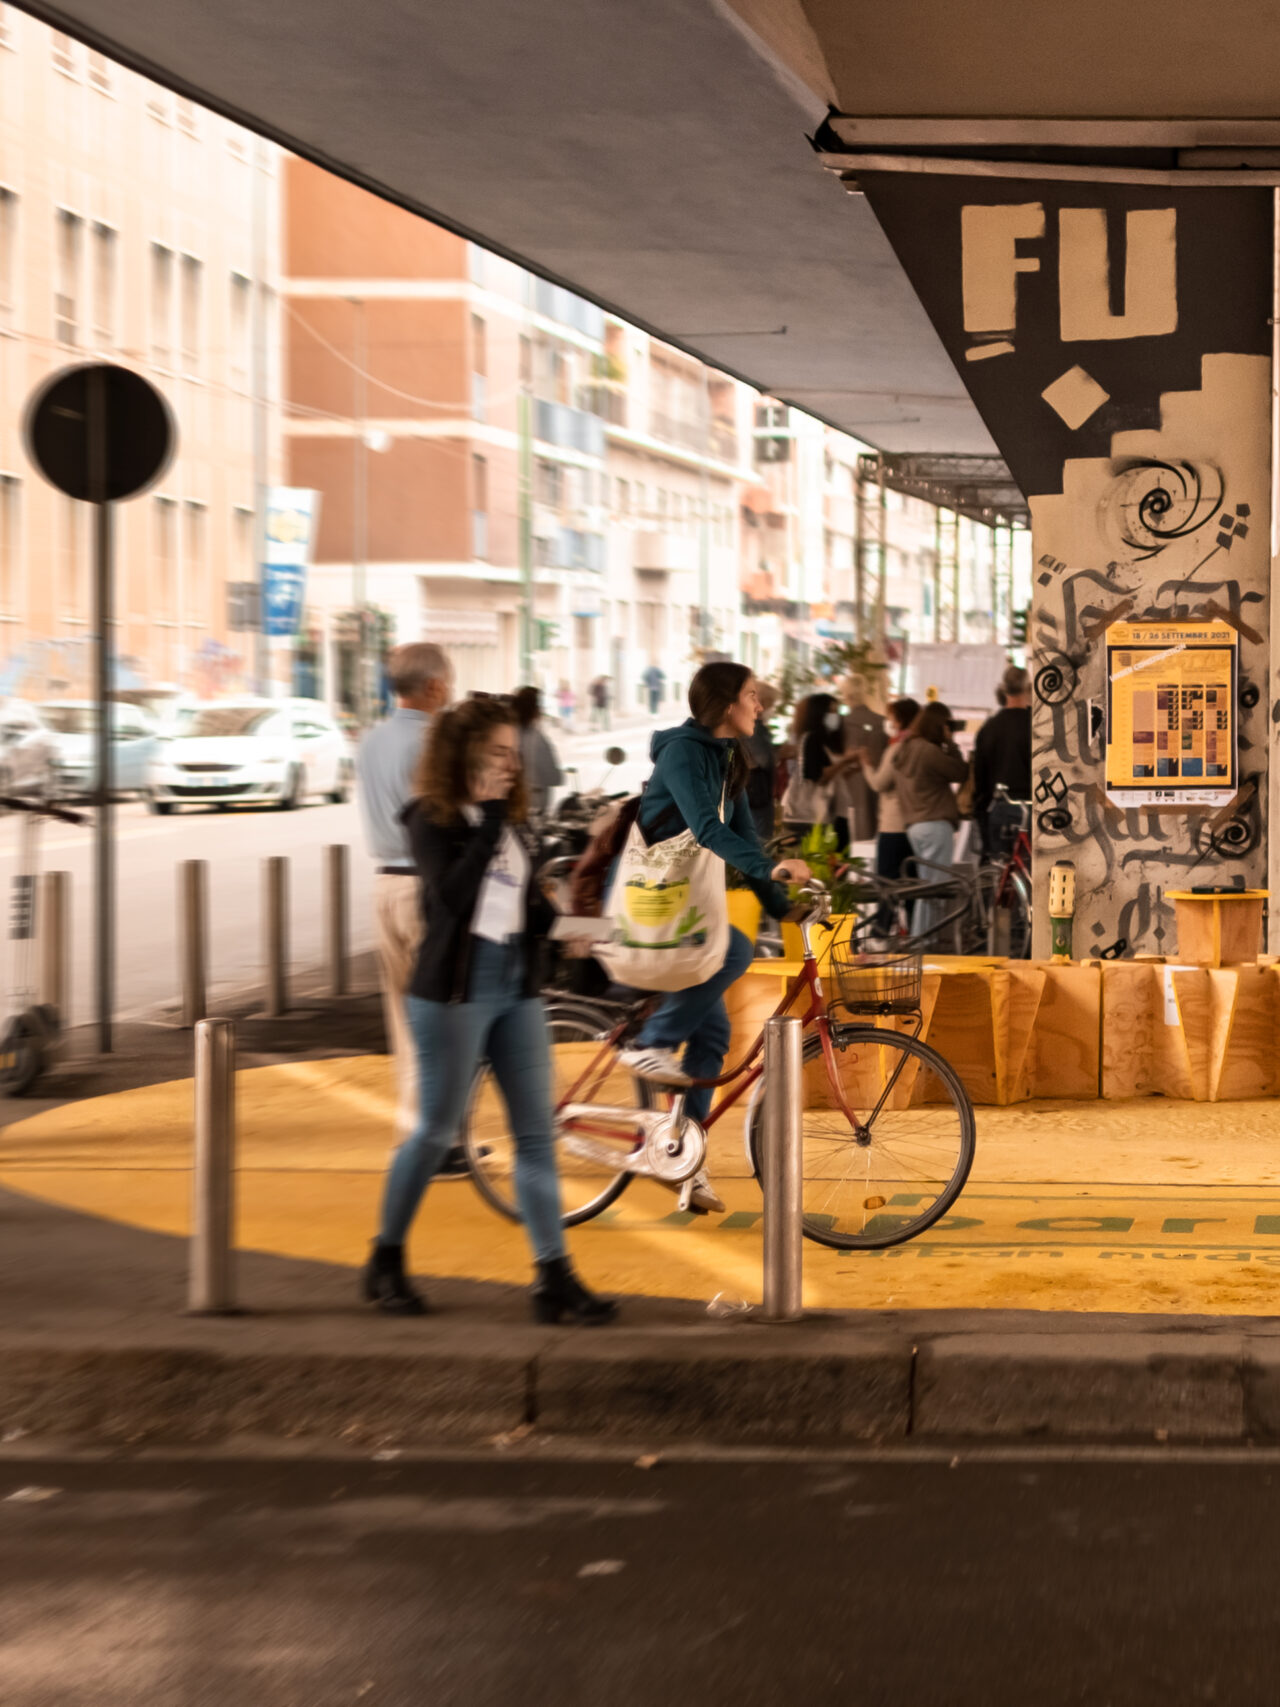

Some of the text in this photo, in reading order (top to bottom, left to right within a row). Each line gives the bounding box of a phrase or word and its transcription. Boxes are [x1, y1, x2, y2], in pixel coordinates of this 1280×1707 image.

[961, 202, 1178, 342] FU
[1132, 632, 1141, 640] 18
[1161, 631, 1208, 639] SETTEMBRE
[1211, 631, 1231, 639] 2021
